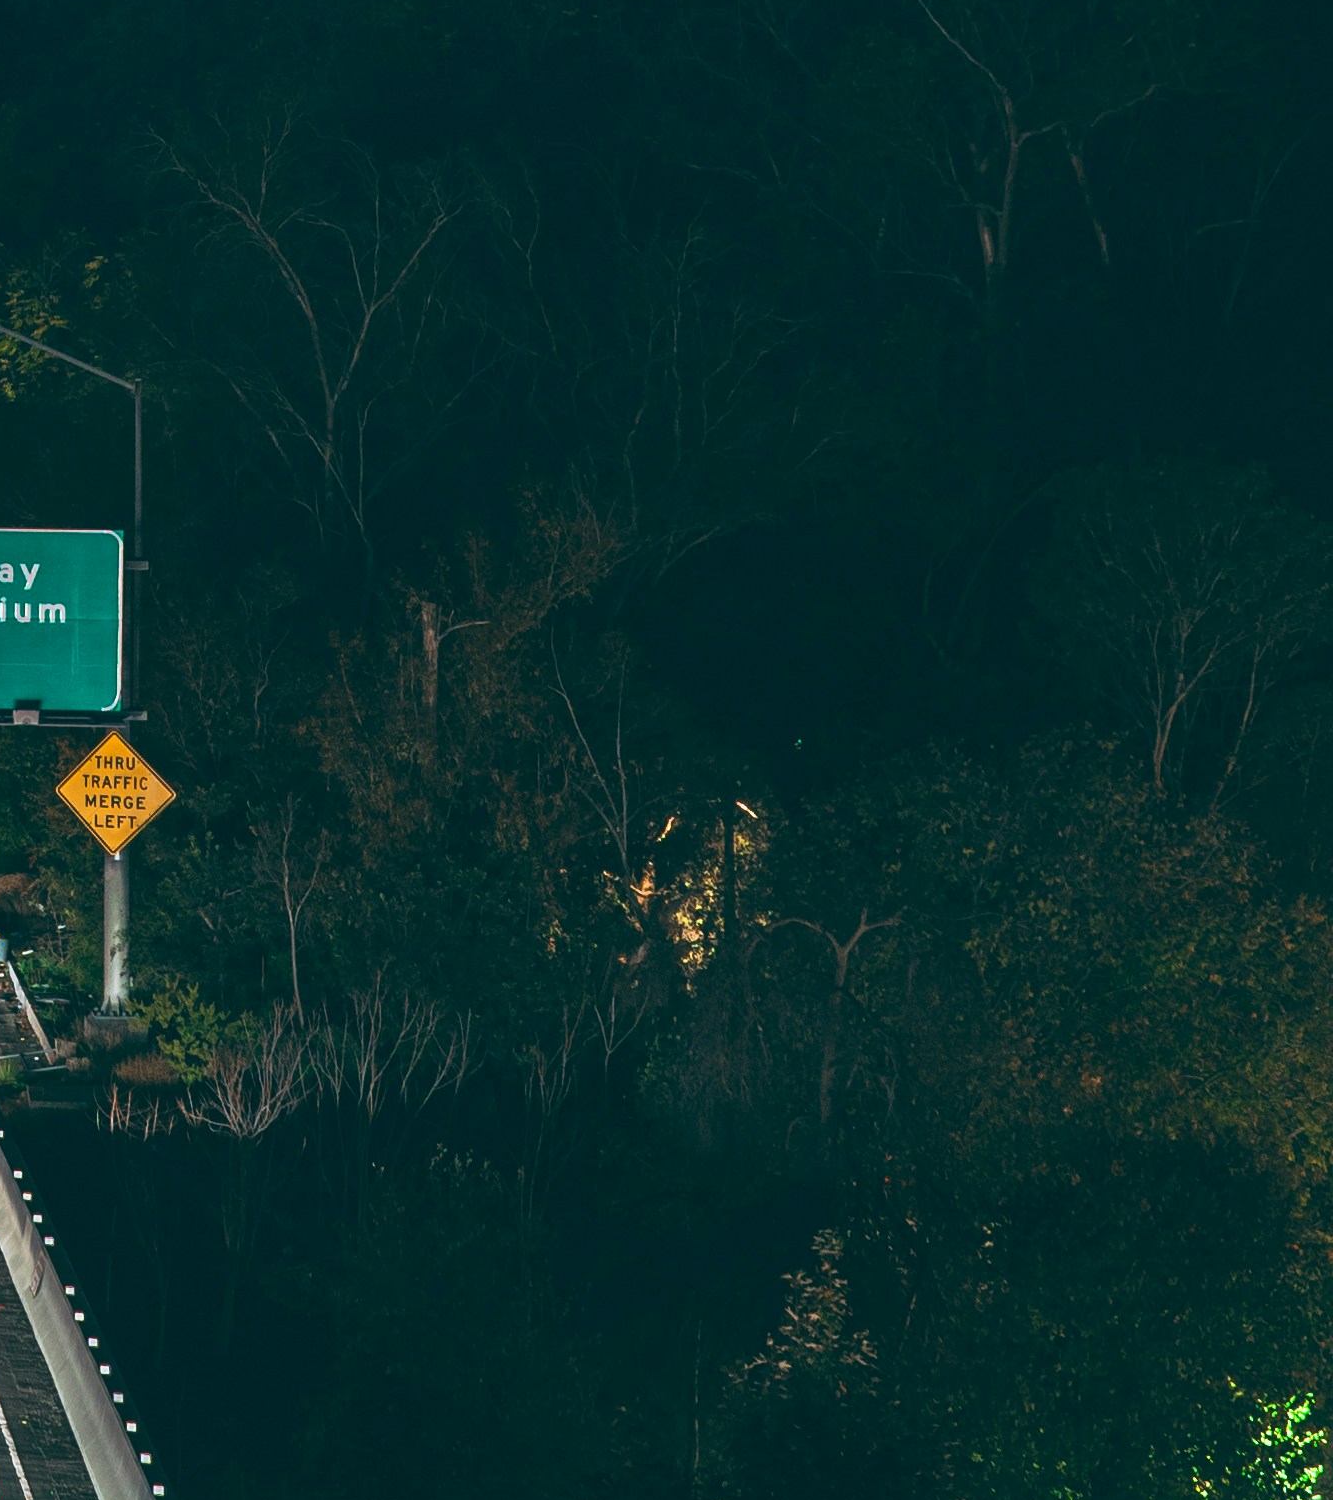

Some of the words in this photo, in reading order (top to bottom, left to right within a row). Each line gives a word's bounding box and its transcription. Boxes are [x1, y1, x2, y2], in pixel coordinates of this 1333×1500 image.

[94, 755, 136, 771] THRU
[82, 774, 148, 791] TRAFFIC
[84, 794, 146, 810] MERGE
[94, 814, 137, 829] LEFT
